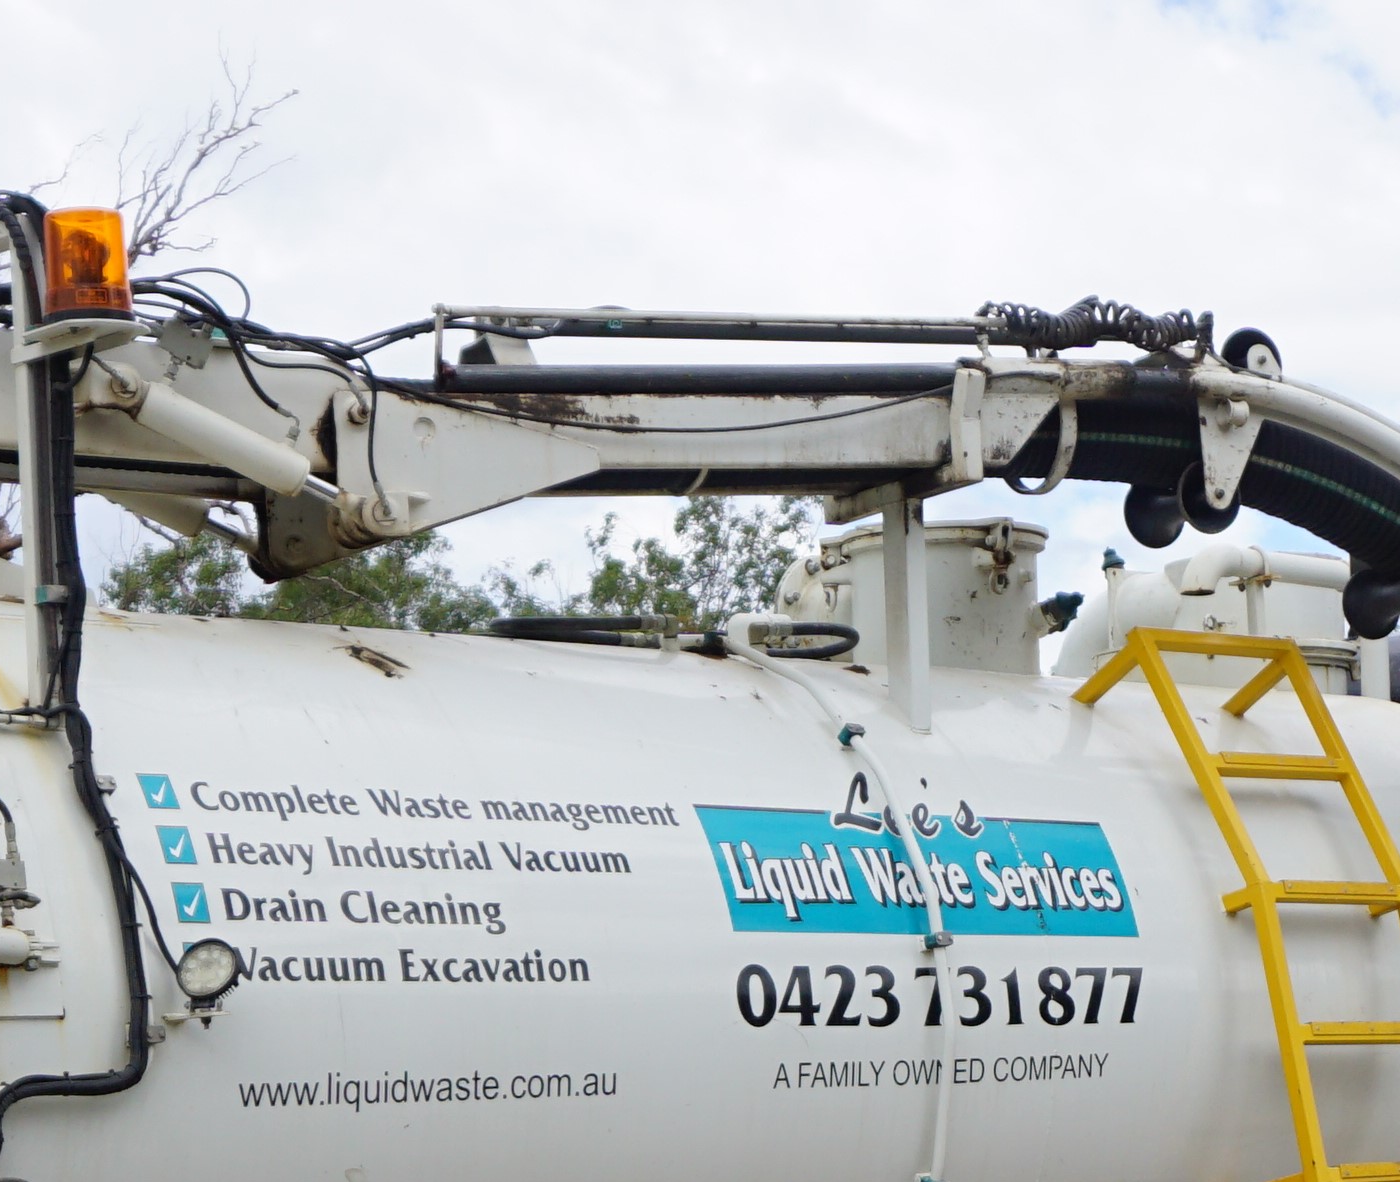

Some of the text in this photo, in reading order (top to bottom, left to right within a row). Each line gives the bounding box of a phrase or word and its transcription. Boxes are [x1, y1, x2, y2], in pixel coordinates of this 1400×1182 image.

[189, 780, 680, 831] Complete Waste management
[205, 832, 632, 875] Heavy Industrial Vacuum
[718, 841, 1125, 921] Liquid Wate Services
[221, 887, 507, 935] Drain Cleaning
[233, 946, 591, 983] Vacuum Excavation
[736, 963, 901, 1027] 0423
[239, 1070, 618, 1112] www.liquidwaste.com.au
[773, 1063, 791, 1089] A
[797, 1060, 885, 1089] FAMILY
[993, 1053, 1110, 1084] COMPANY
